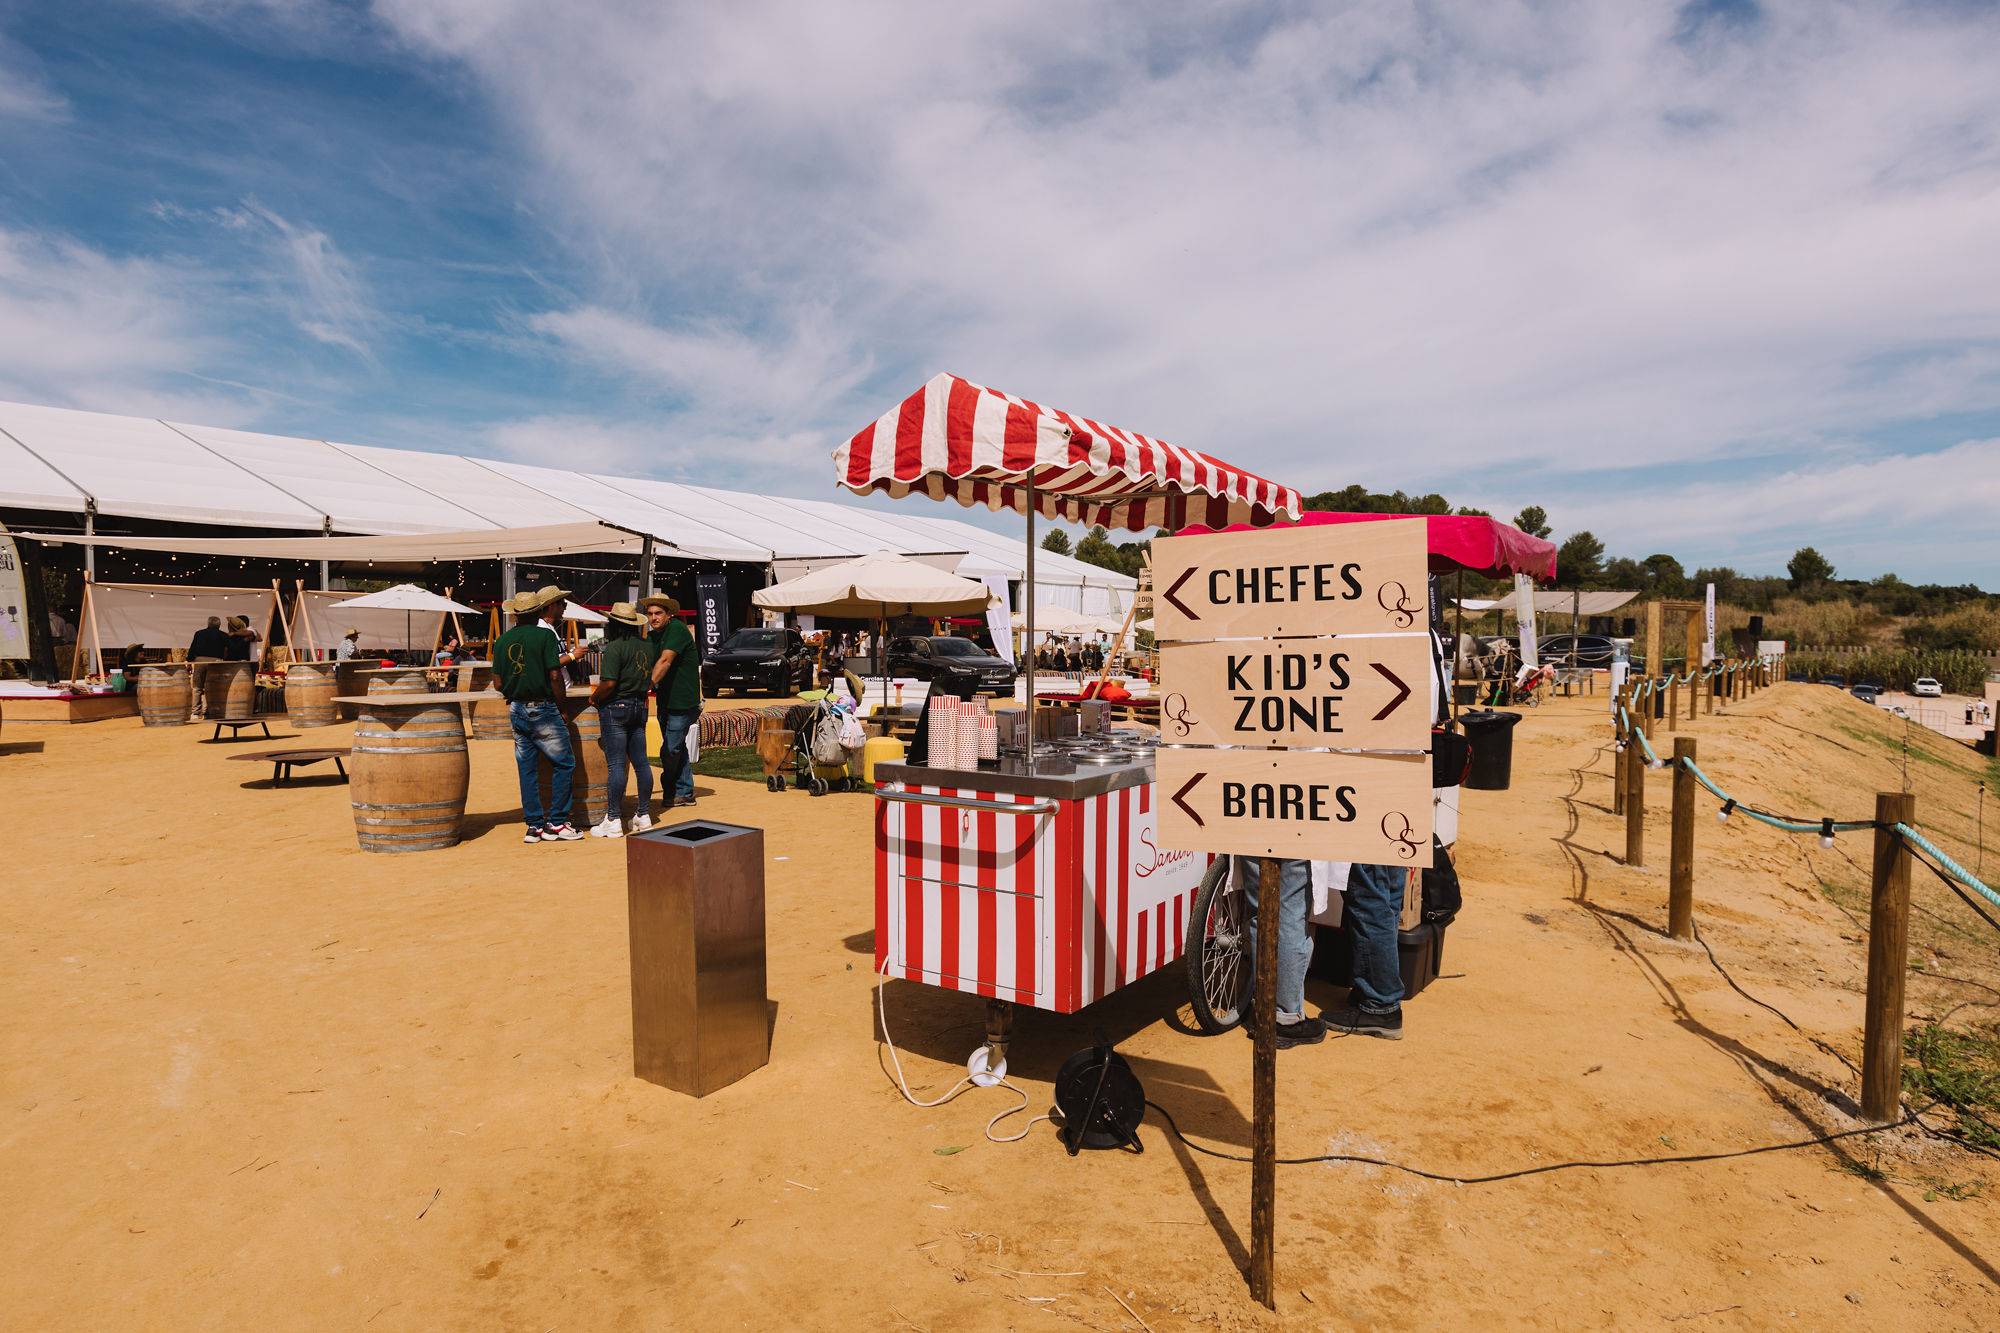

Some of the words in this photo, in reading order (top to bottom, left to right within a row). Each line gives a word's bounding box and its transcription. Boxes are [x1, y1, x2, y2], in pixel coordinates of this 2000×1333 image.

[1138, 595, 1154, 603] LOUN
[1208, 563, 1363, 605] CHEFES
[860, 675, 891, 683] Carclase
[1227, 652, 1351, 691] KID'S
[1233, 696, 1344, 733] ZONE
[1223, 782, 1357, 823] BARES
